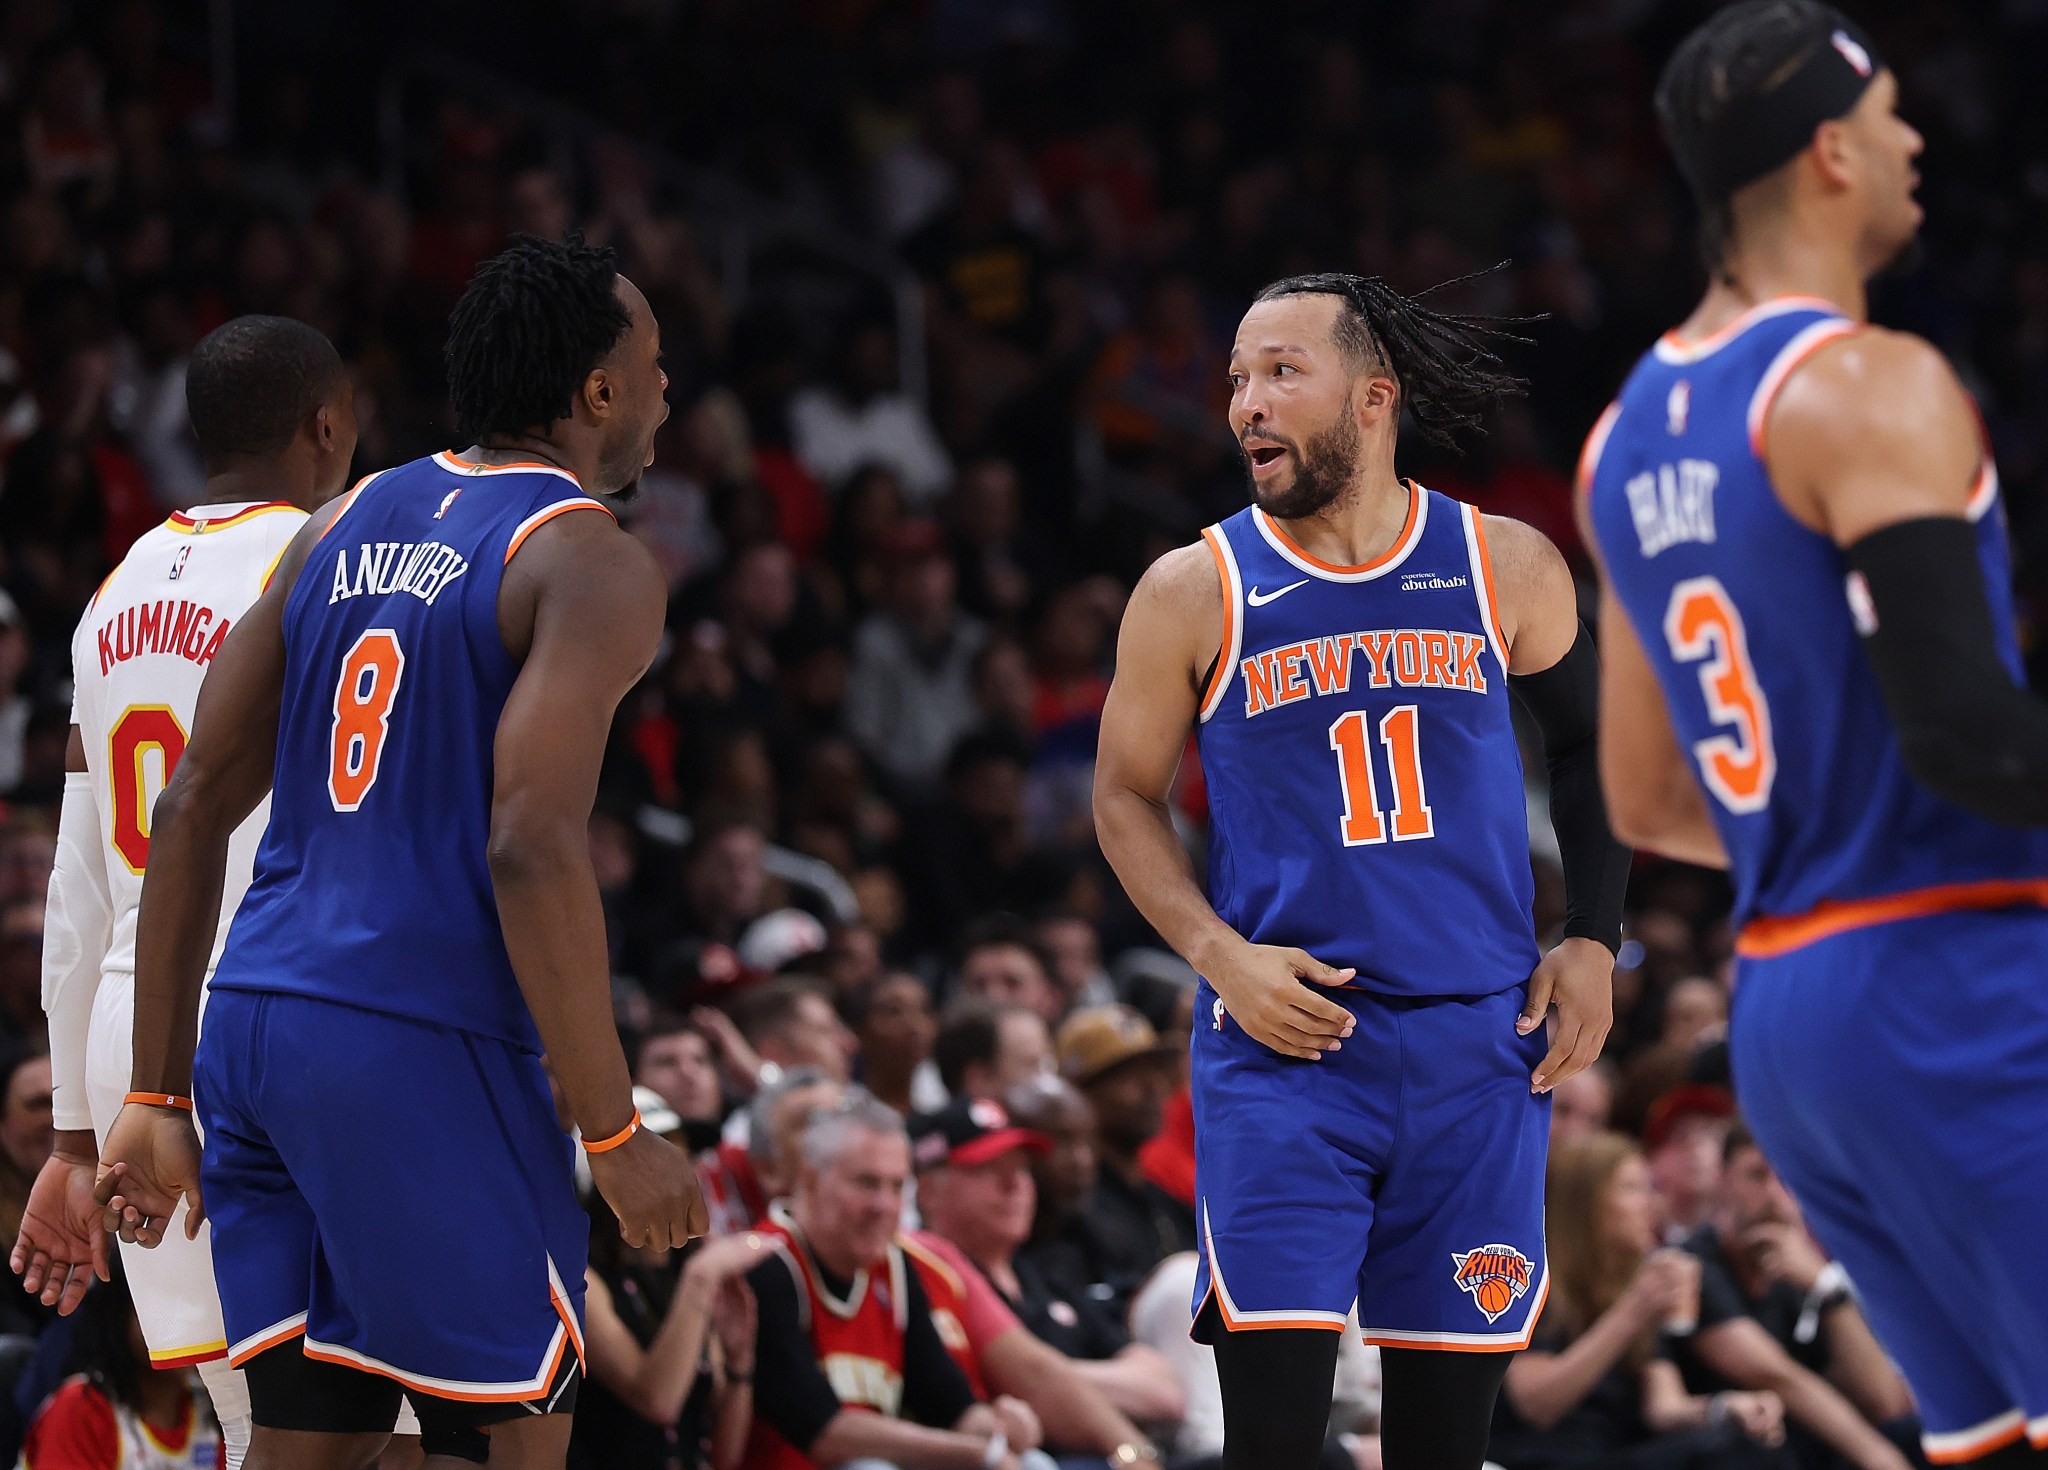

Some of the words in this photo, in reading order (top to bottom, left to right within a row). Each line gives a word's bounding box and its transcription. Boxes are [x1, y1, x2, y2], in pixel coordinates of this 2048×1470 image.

[329, 542, 469, 606] ANUNOBY
[1401, 572, 1436, 580] experience
[1401, 579, 1428, 591] abu
[1429, 574, 1467, 589] dhabi
[98, 600, 230, 677] KUMINGA
[1240, 632, 1354, 718] NEW
[1356, 628, 1488, 695] YORK
[327, 628, 406, 813] 8
[1664, 575, 1777, 815] 3
[108, 704, 190, 876] 0
[1328, 705, 1435, 847] 11
[1458, 1251, 1528, 1288] KNICKS
[1484, 1246, 1499, 1254] NEW
[1500, 1247, 1515, 1257] YORK
